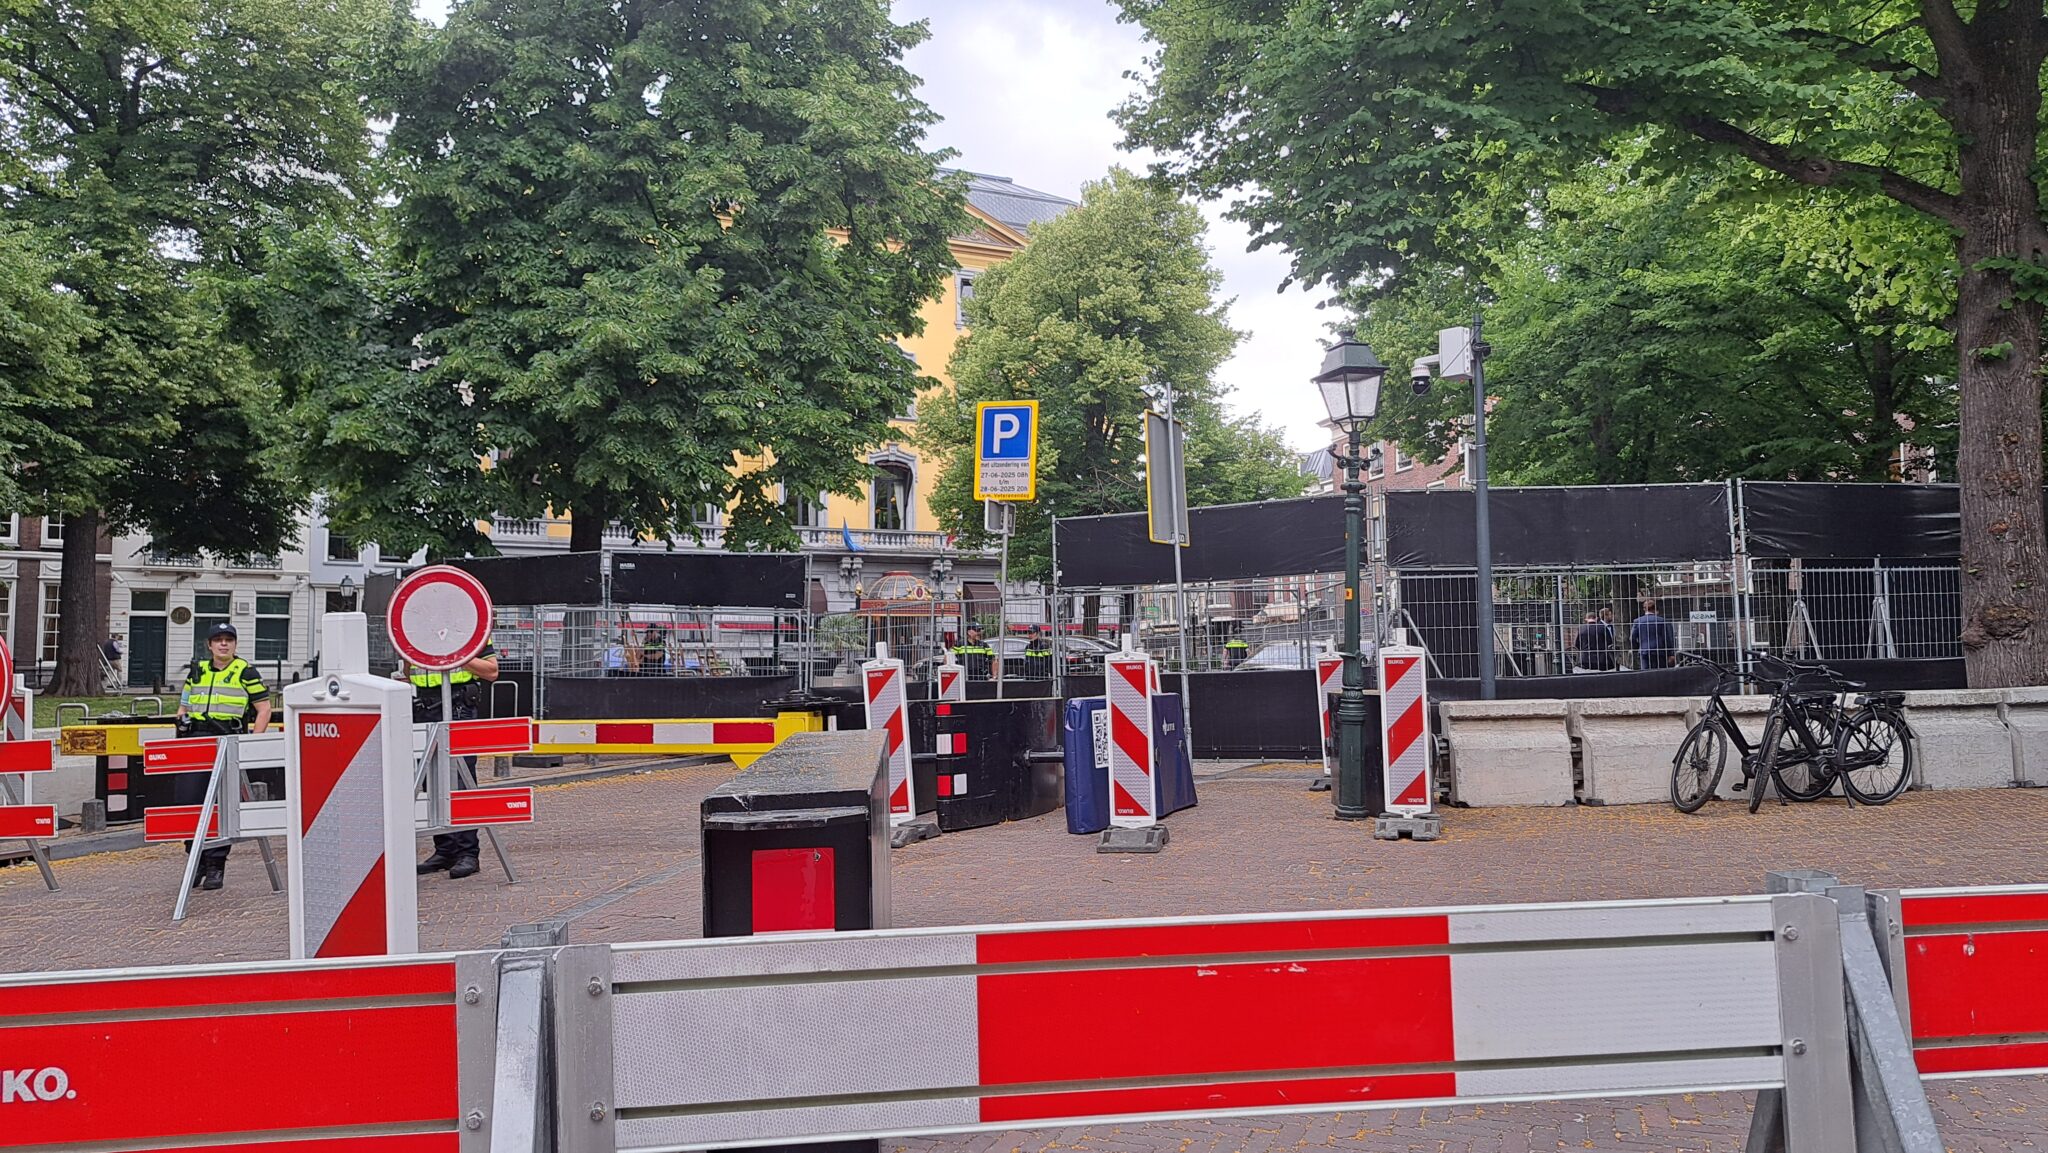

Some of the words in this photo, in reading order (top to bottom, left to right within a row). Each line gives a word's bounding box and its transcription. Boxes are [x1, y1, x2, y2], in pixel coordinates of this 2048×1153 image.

[993, 413, 1020, 454] P
[304, 722, 341, 738] BUKO.
[148, 753, 168, 761] BUKO.
[0, 1066, 77, 1104] KO.
